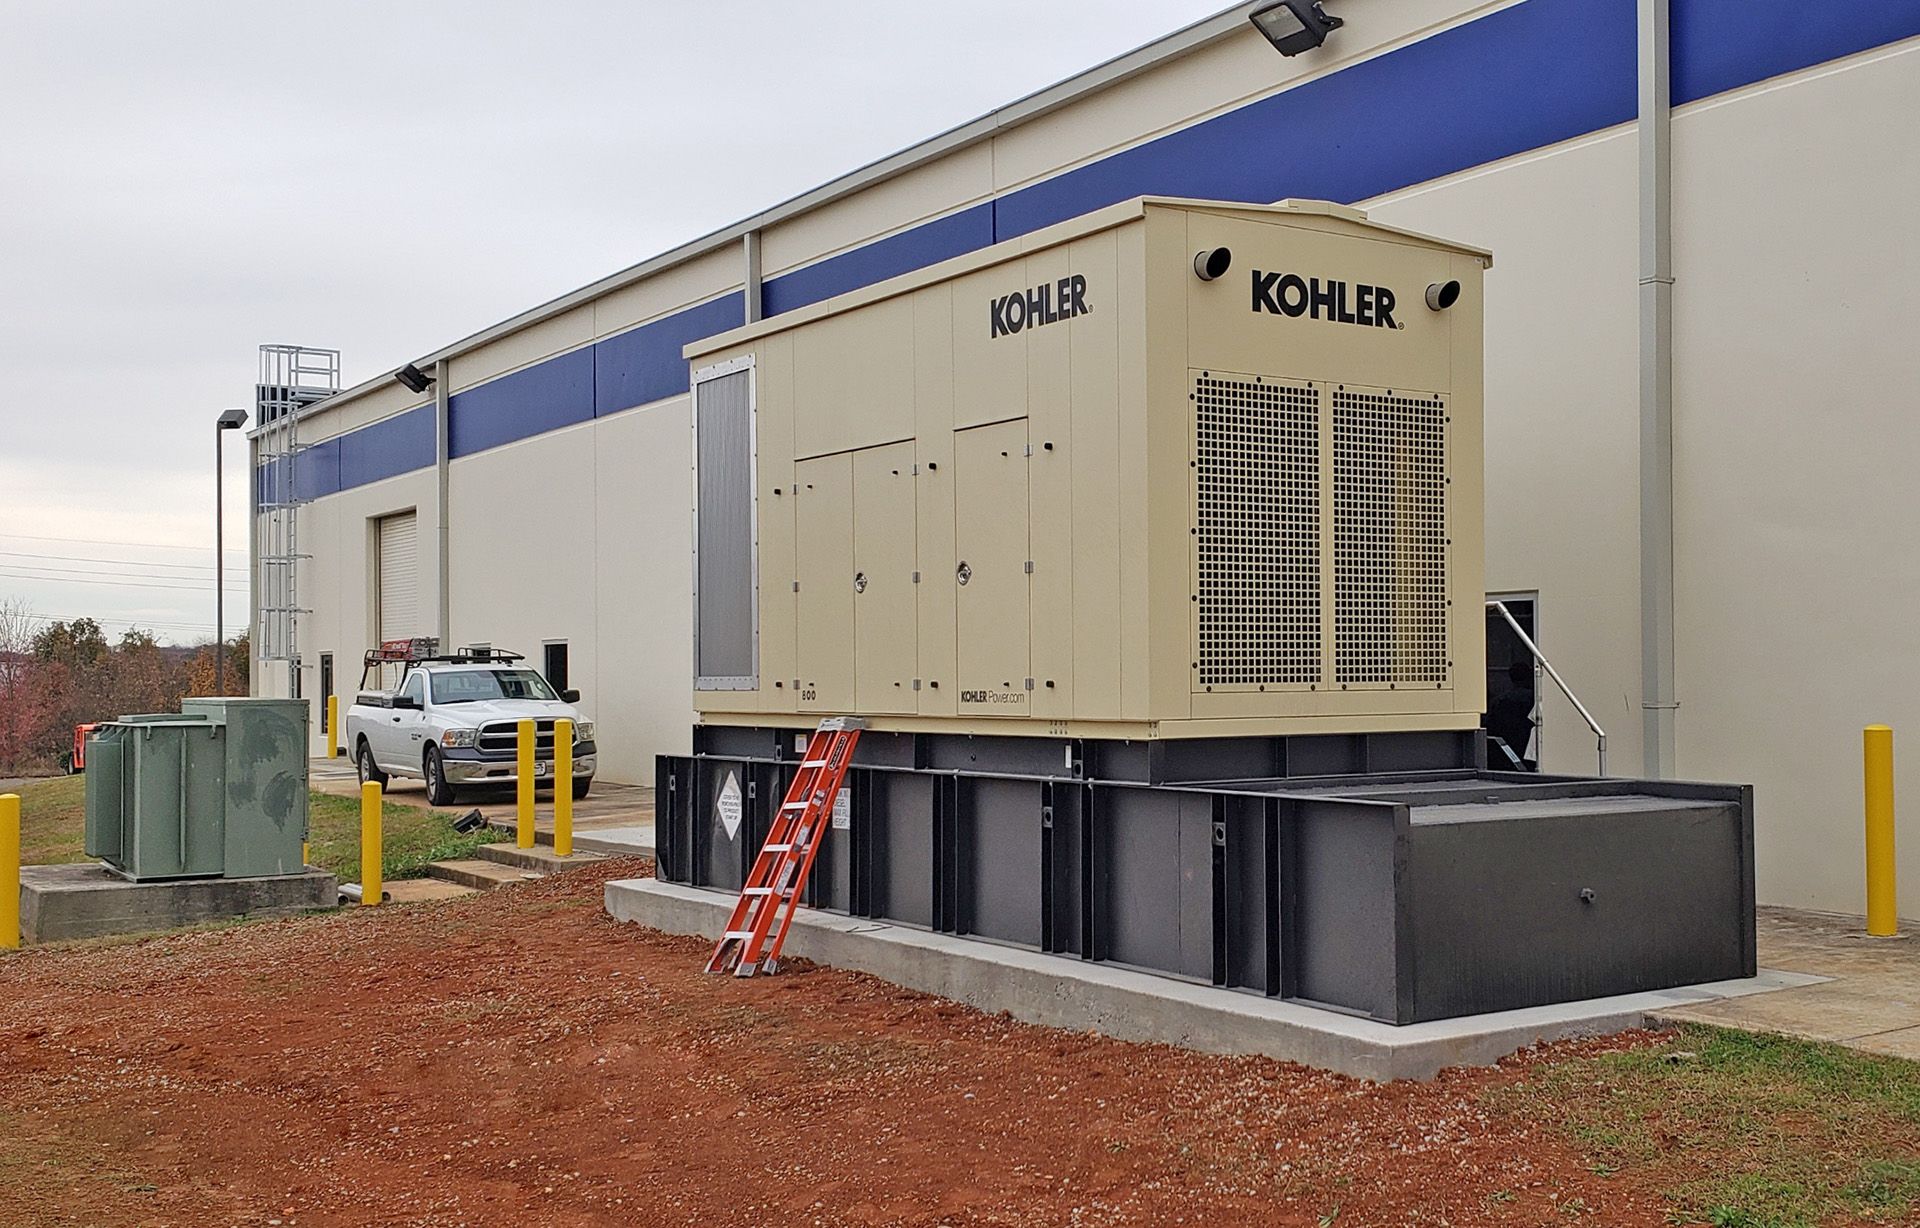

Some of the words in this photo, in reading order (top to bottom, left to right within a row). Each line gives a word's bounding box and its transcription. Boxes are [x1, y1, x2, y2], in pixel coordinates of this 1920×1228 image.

[990, 274, 1089, 339] KOHLER
[1251, 269, 1398, 330] KOHLER
[802, 690, 816, 701] 800
[961, 690, 988, 703] KOHLER
